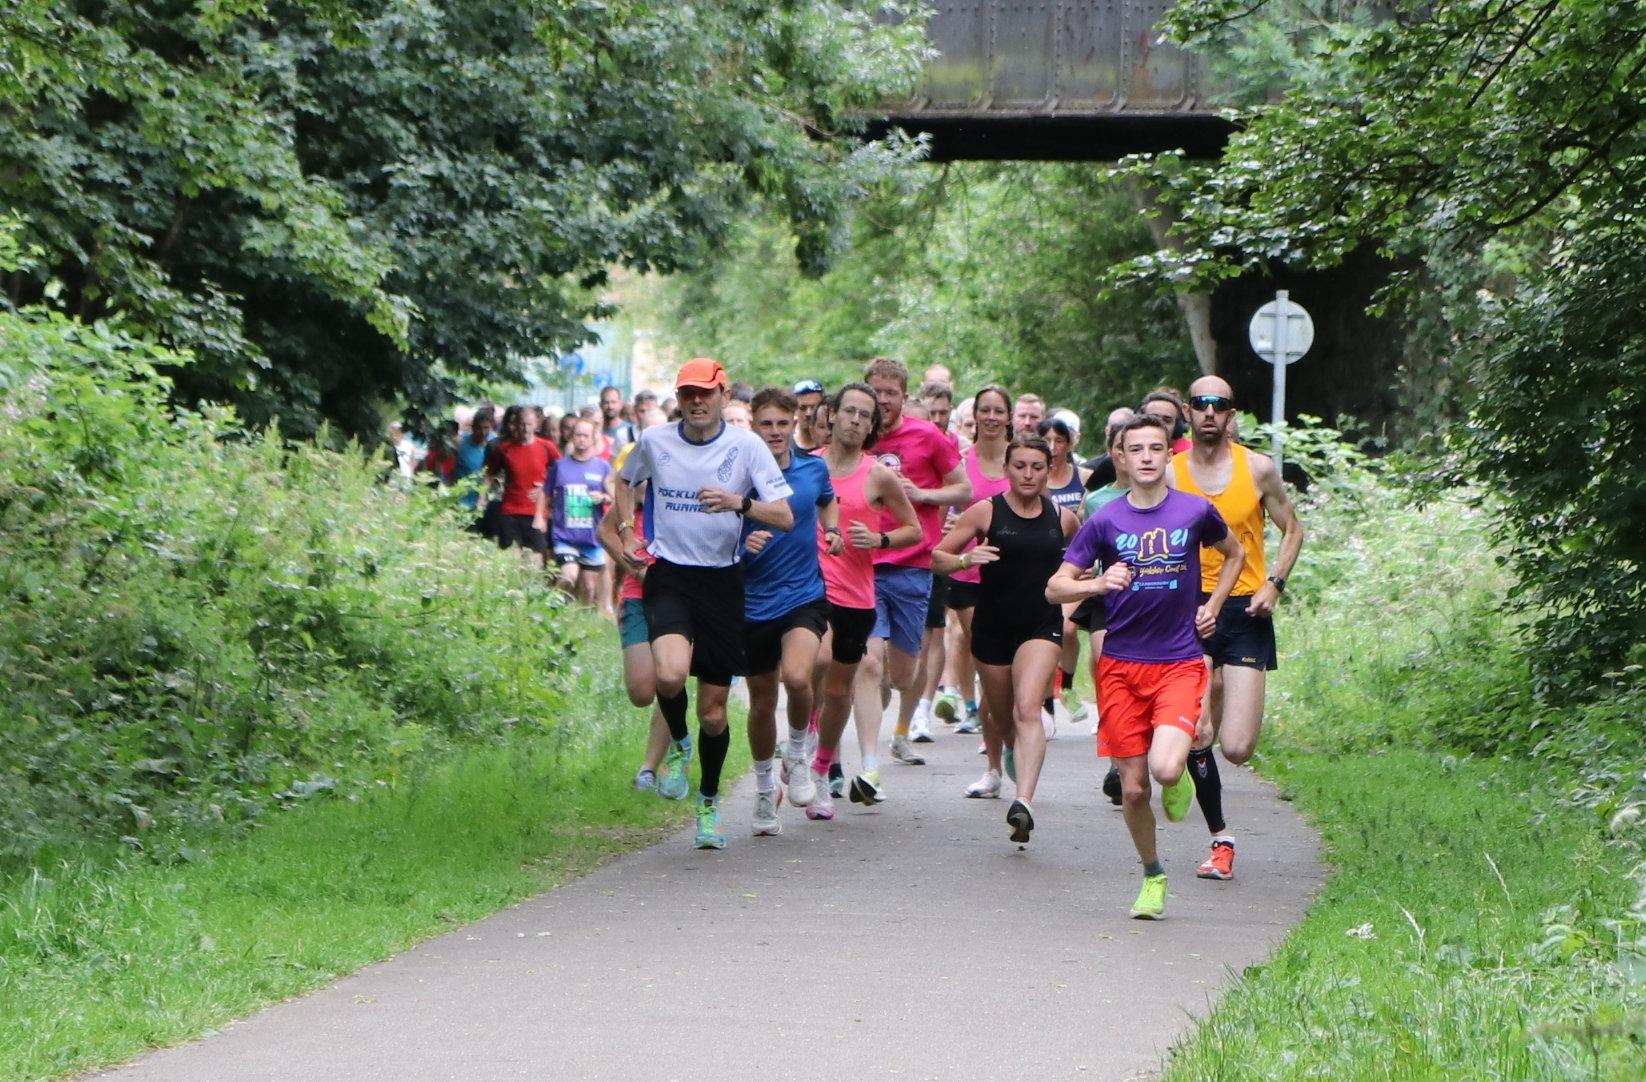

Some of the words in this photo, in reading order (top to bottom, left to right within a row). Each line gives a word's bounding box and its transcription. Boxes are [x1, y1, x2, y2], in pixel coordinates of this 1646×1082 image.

[665, 502, 704, 513] RUNNE
[1115, 533, 1138, 551] 20
[1169, 528, 1188, 547] 21
